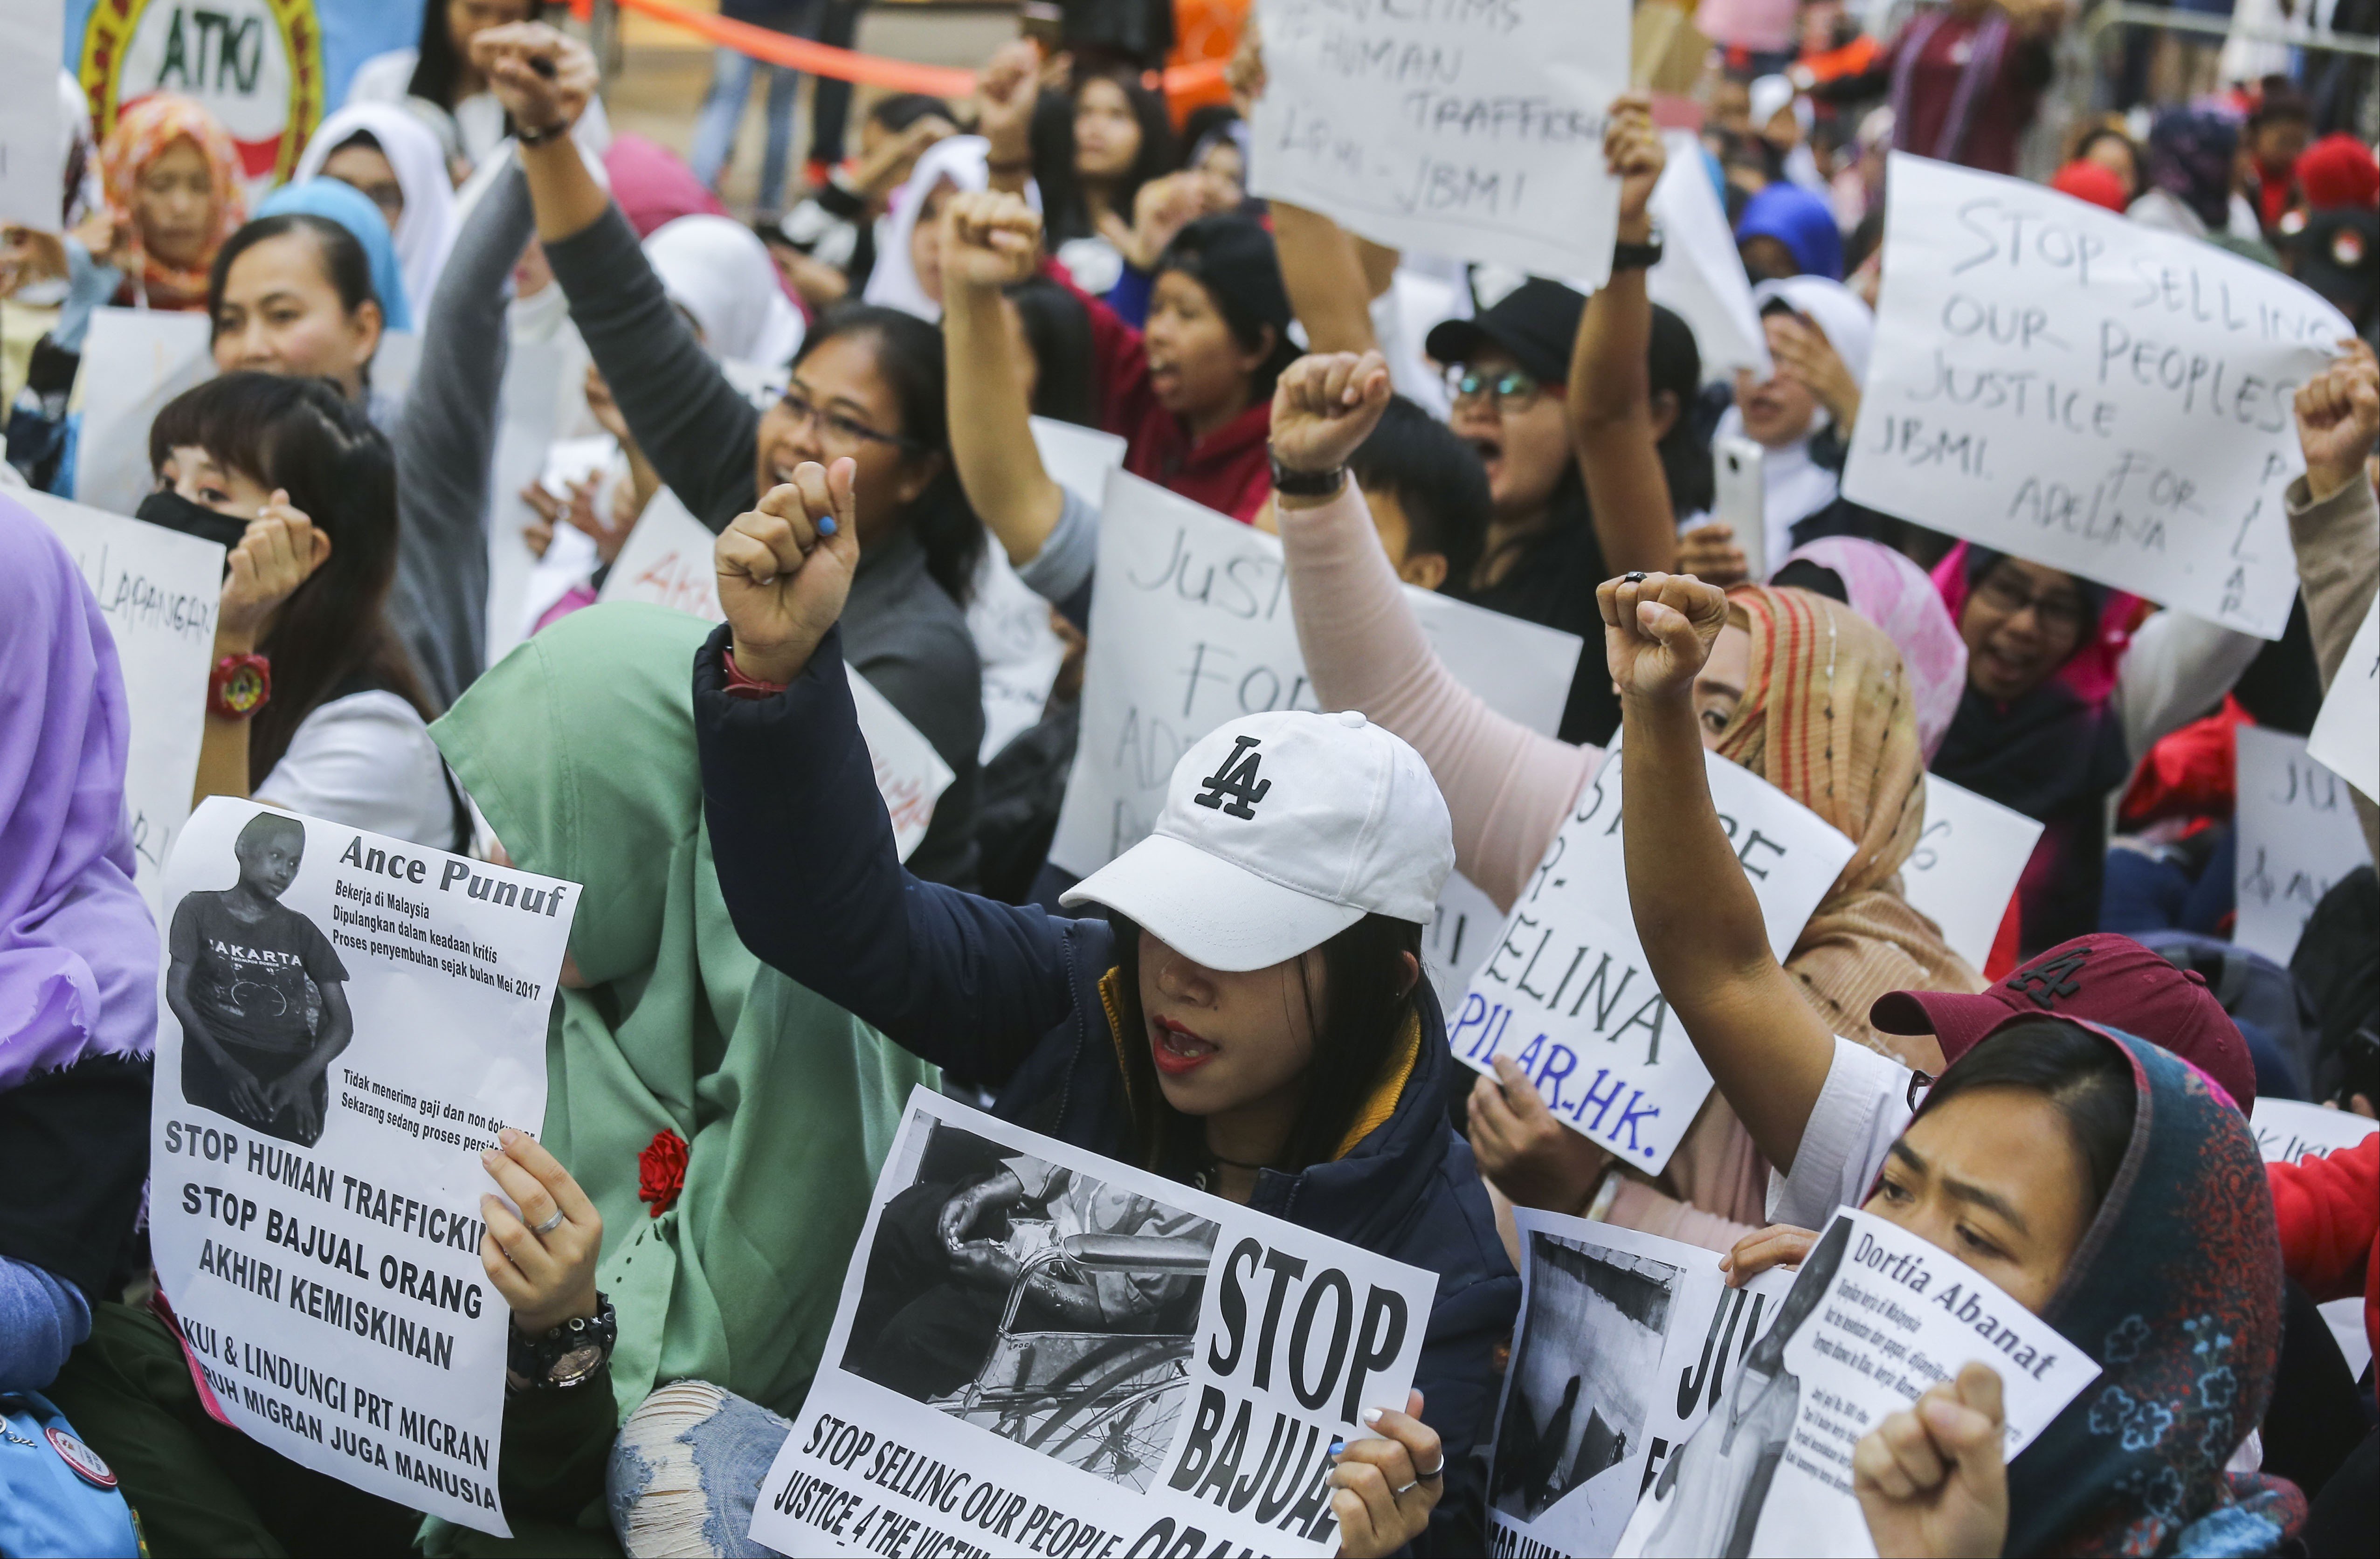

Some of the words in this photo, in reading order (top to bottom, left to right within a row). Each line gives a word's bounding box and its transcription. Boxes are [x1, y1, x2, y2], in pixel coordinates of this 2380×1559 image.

[157, 7, 263, 93] ATKI
[1953, 196, 2106, 287] STOP
[1906, 348, 2120, 437] JUSTICE
[1942, 294, 2071, 352] OUR
[2100, 317, 2302, 434] PEOPLES
[2105, 446, 2208, 517] FOR
[1194, 735, 1272, 821] LA
[335, 879, 372, 905] Bekerja
[375, 891, 384, 907] di
[388, 893, 429, 921] Malaysia
[339, 835, 426, 884] Ance
[439, 859, 567, 917] Punuf
[333, 905, 395, 934] Dipulangkan
[399, 921, 428, 943] dalam
[430, 929, 470, 956] keadaan
[473, 941, 498, 964] kritis
[333, 929, 367, 952] Proses
[370, 940, 439, 970] penyembuhan
[442, 958, 467, 979] sejak
[470, 964, 495, 987] bulan
[497, 974, 514, 994] Mei
[516, 980, 541, 1002] 2017
[342, 1092, 385, 1124] Sekarang
[387, 1112, 420, 1138] sedang
[422, 1124, 460, 1146] proses
[344, 1069, 369, 1091] Tidak
[373, 1082, 417, 1109] menerima
[420, 1099, 441, 1118] gaji
[443, 1104, 464, 1123] dan
[468, 1111, 486, 1129] non
[165, 1120, 239, 1167] STOP
[248, 1140, 335, 1204] HUMAN
[182, 1182, 257, 1233] STOP
[266, 1207, 370, 1280] BAJUAL
[380, 1255, 483, 1319] ORANG
[199, 1239, 282, 1303] AKHIRI
[290, 1278, 454, 1371] KEMISKINAN
[1207, 1237, 1408, 1428] STOP
[1854, 1233, 1932, 1294] Dortia
[1932, 1283, 2059, 1382] Abanat
[176, 1314, 218, 1359] KUI
[224, 1336, 239, 1368] &
[245, 1342, 347, 1408] LINDUNGI
[353, 1388, 393, 1432] PRT
[400, 1406, 490, 1471] MIGRAN
[198, 1360, 240, 1404] RUH
[243, 1386, 323, 1444] MIGRAN
[330, 1427, 389, 1471] JUGA
[395, 1450, 497, 1513] MANUSIA
[802, 1414, 876, 1472] STOP
[864, 1441, 972, 1513] SELLING
[960, 1482, 1027, 1539] OUR
[1014, 1504, 1124, 1559] PEOPLE
[867, 1508, 921, 1559] THE
